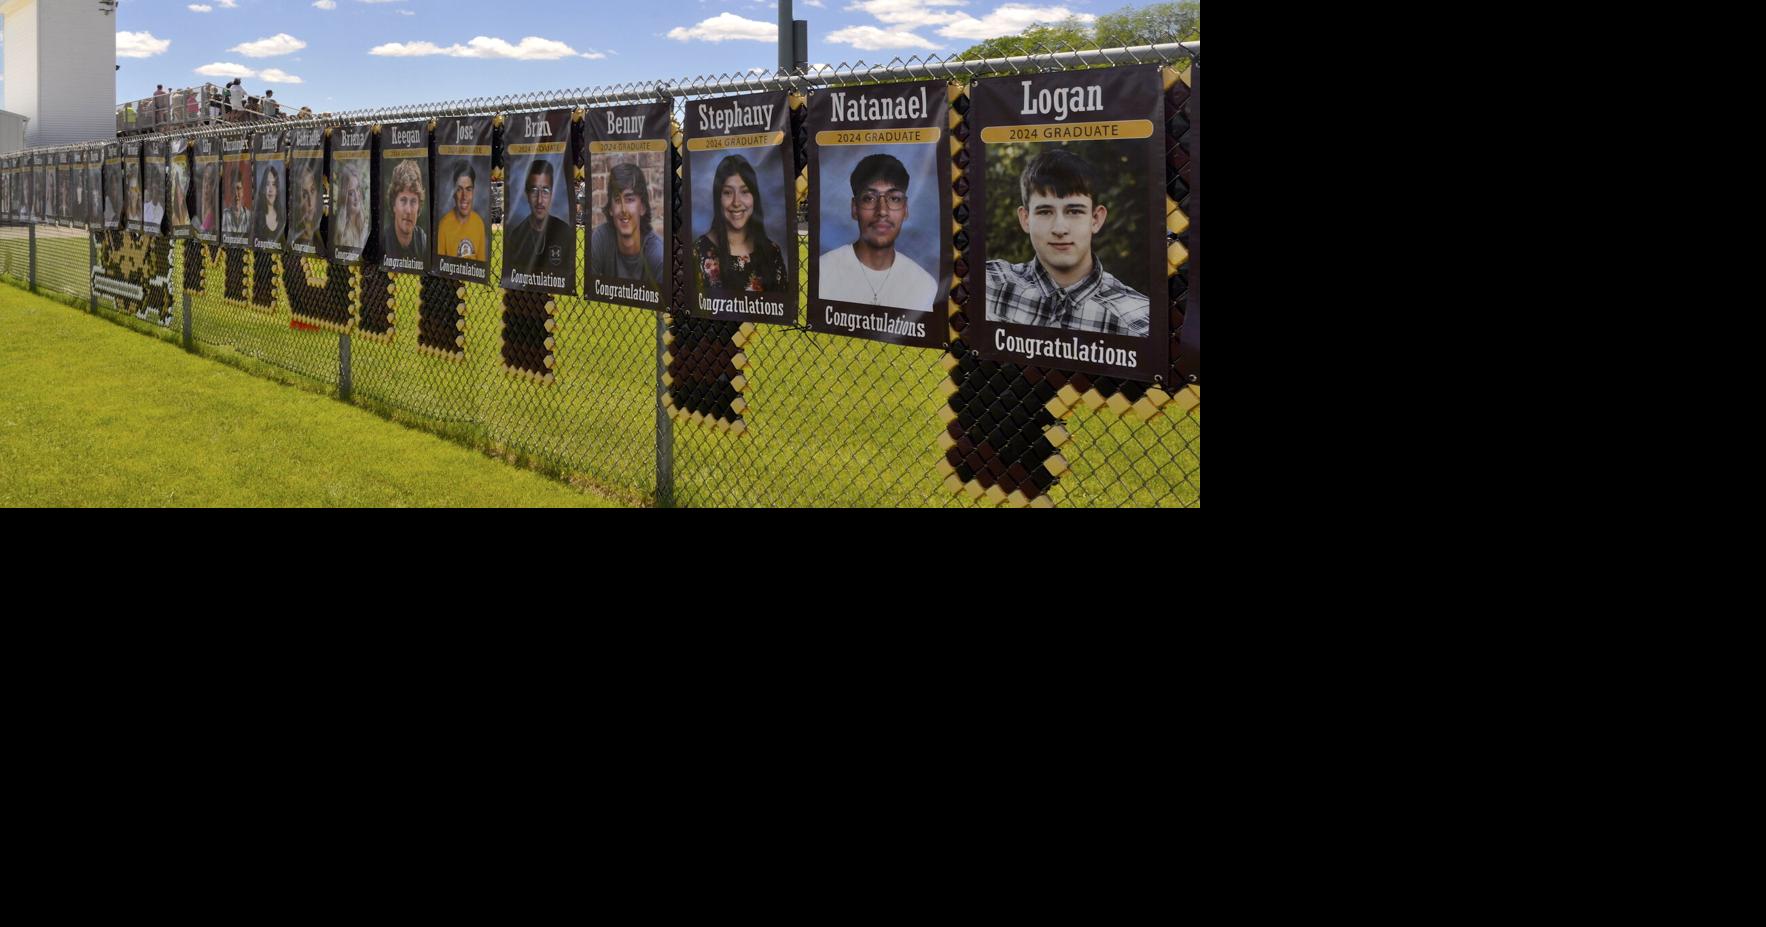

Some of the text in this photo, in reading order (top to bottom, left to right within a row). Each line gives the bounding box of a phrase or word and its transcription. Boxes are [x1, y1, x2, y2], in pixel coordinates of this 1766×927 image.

[830, 87, 928, 123] Natanael
[1020, 80, 1104, 121] Logan
[606, 110, 646, 138] Benny
[698, 101, 774, 134] Stephany
[341, 130, 365, 147] Briana
[391, 126, 421, 148] Keegan
[455, 120, 474, 144] Jose
[705, 135, 769, 149] 2024 GRADUATE
[837, 131, 921, 143] 2024 GRADUATE
[1009, 124, 1120, 141] 2024 GRADUATE
[529, 143, 561, 153] ADUATE
[600, 142, 651, 151] 2024 GRADUATE
[383, 254, 424, 270] Congratulations
[439, 258, 486, 279] Congratulations
[510, 268, 566, 289] Congratulations
[595, 279, 660, 304] Congratulations
[698, 292, 784, 316] Congratulations
[825, 305, 926, 338] Congratulations
[994, 328, 1137, 369] Congratulations
